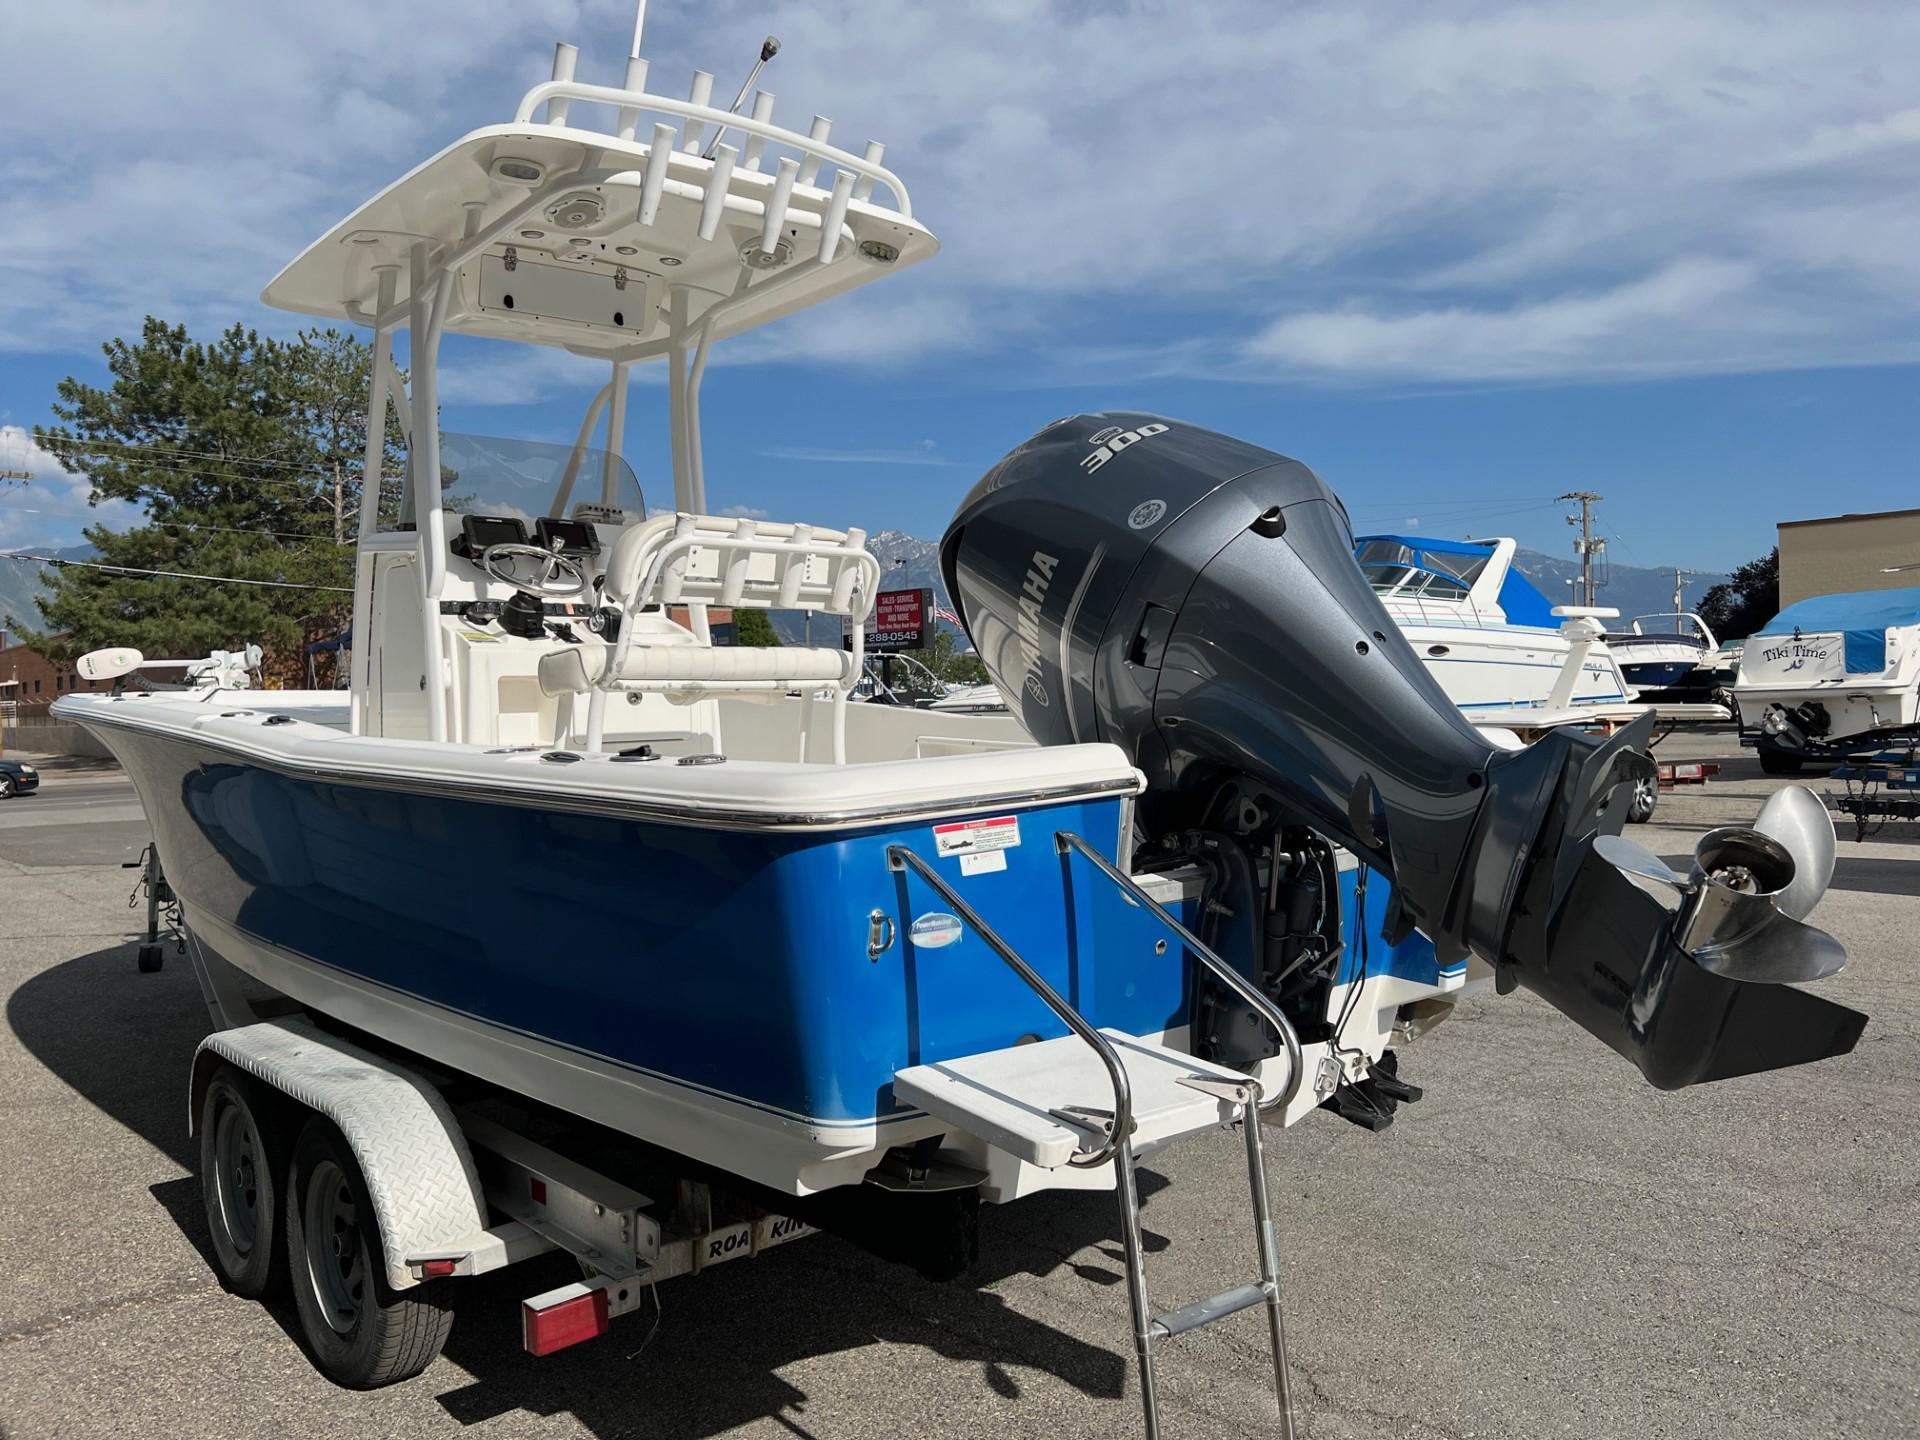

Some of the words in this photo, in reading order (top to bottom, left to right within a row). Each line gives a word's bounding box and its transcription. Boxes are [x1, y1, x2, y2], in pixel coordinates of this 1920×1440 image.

[1080, 423, 1170, 474] 300
[1017, 550, 1059, 679] YAMAHA
[848, 631, 918, 643] 8-288-0545
[1762, 646, 1789, 662] Tiki
[1792, 645, 1827, 660] Time
[709, 1230, 748, 1258] ROA
[771, 1216, 806, 1238] KIN
